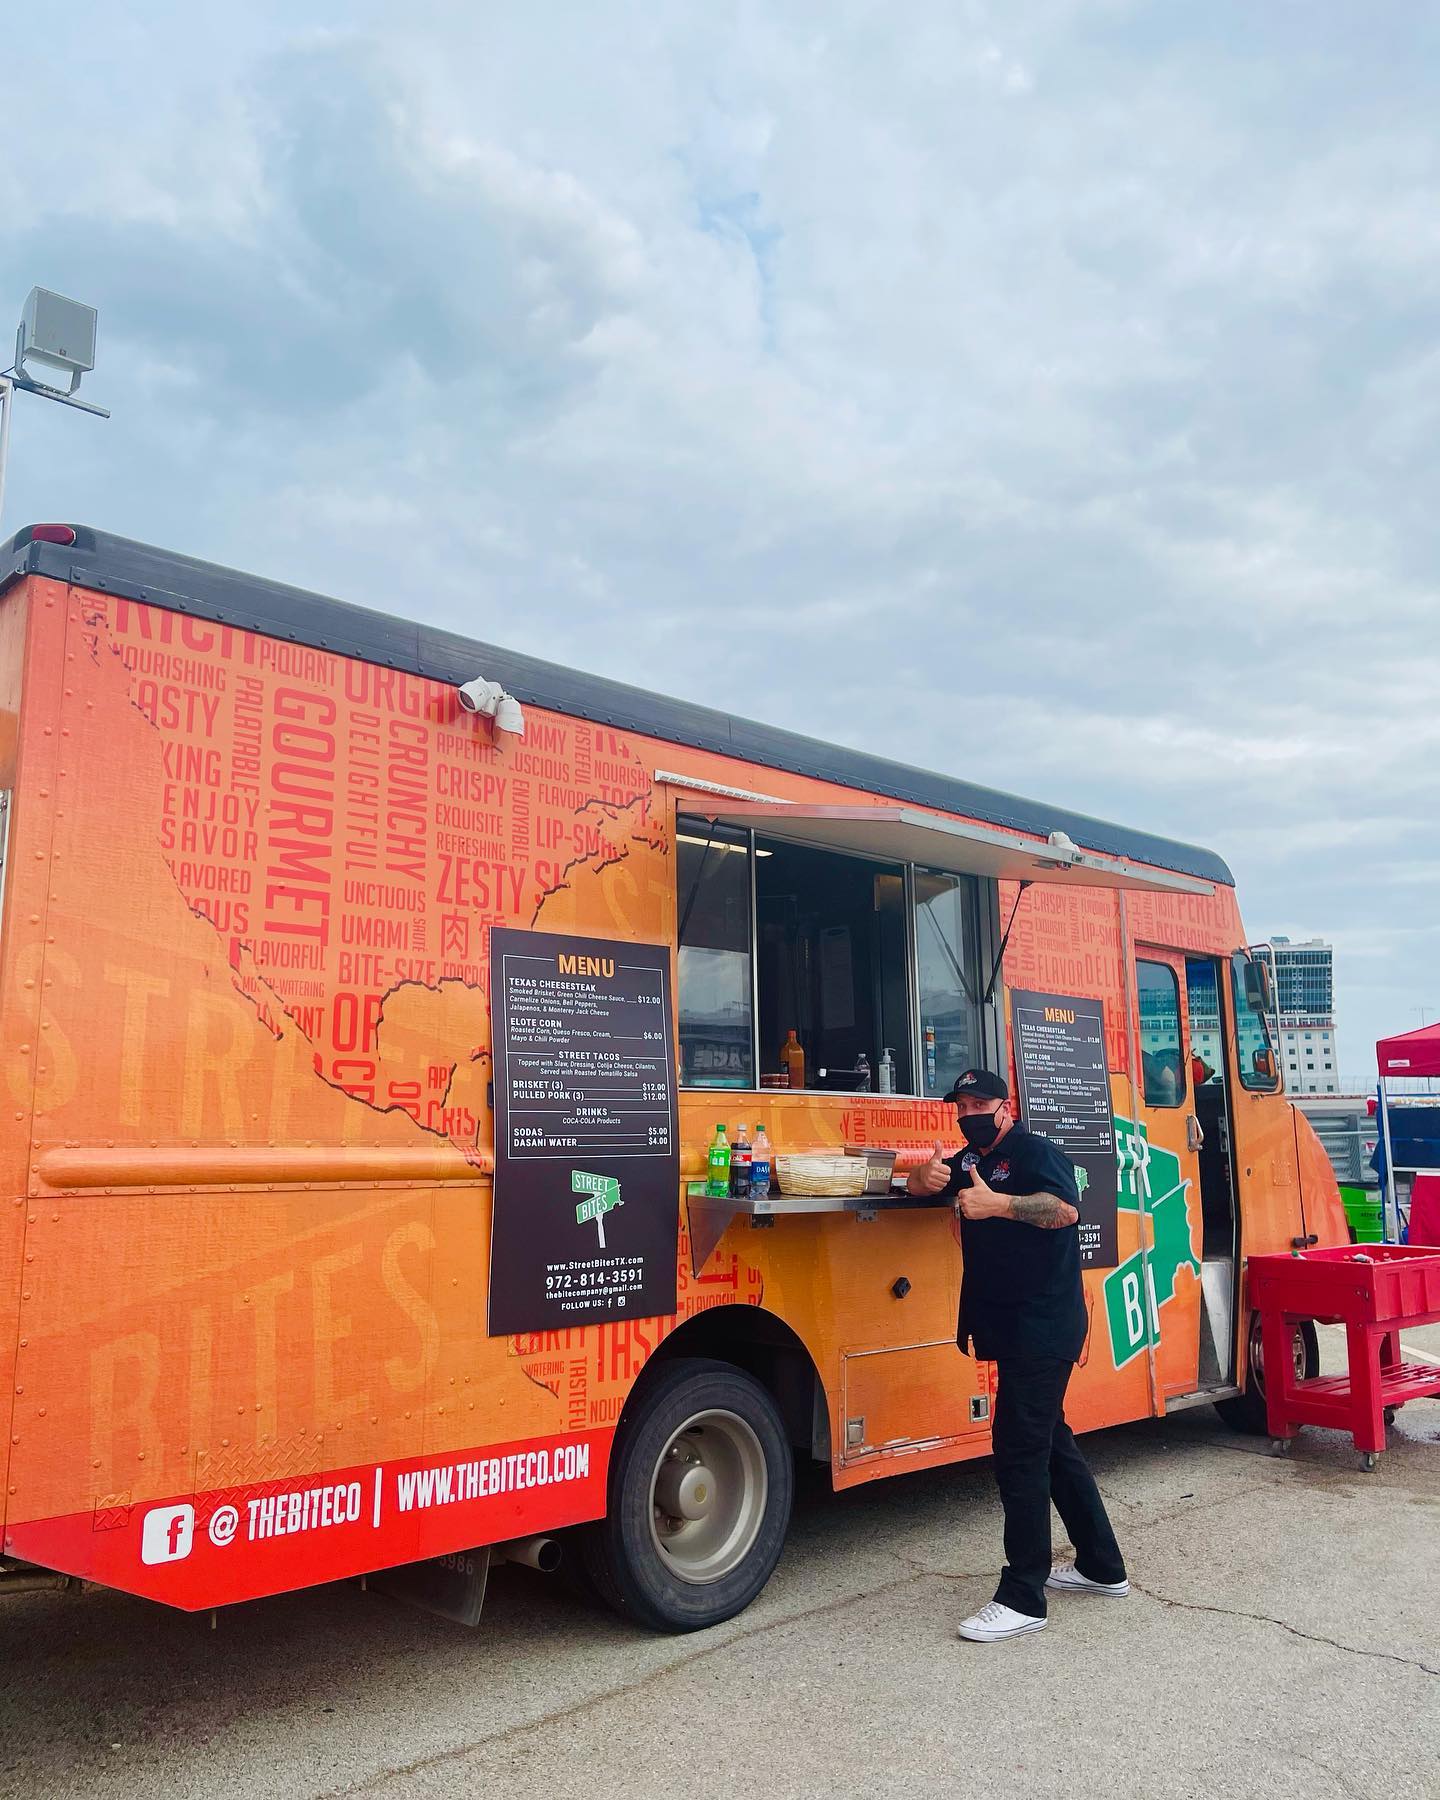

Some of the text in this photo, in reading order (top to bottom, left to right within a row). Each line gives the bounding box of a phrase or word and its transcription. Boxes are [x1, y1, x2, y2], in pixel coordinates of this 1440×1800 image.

[260, 639, 338, 687] PIQUANT
[133, 676, 220, 738] ASTY
[231, 675, 264, 796] PALATABLE
[437, 731, 498, 767] APPETITE
[346, 711, 381, 869] DELIGHTFUL
[436, 763, 507, 806] CRISPY
[163, 784, 260, 827] ENJOY
[385, 719, 429, 883] CRUNCHY
[264, 687, 337, 946] GOURMET
[436, 803, 503, 837] EXQUISITE
[512, 778, 530, 863] ENJOYABLE
[160, 818, 258, 861] SAVOR
[437, 831, 506, 861] REFRESHING
[436, 853, 526, 914] ZESTY
[344, 879, 426, 913] UNCTUOUS
[342, 914, 408, 950] UMAMI
[338, 952, 437, 990] BITE-SIZE
[558, 953, 615, 978] MENU
[509, 978, 596, 992] TEXAS CHEESESTEAK
[509, 987, 533, 996] Smoked
[557, 991, 574, 999] Green
[588, 993, 608, 1001] Cheese
[608, 994, 626, 1003] Sauce,
[637, 995, 661, 1004] $12.00
[509, 995, 539, 1004] Carmelize
[562, 999, 575, 1007] Bell
[576, 1000, 598, 1009] Peppers,
[548, 1006, 575, 1015] Monterey
[575, 1008, 589, 1016] Jack
[589, 1009, 609, 1017] Cheese
[510, 1017, 562, 1028] ELOTE CORN
[1044, 1007, 1075, 1024] MENU
[510, 1026, 663, 1040] Roasted Corn, Queso Fresco, Cream, $6.00
[510, 1034, 528, 1043] Mayo
[518, 1058, 540, 1067] Topped
[558, 1051, 620, 1061] STREET TACOS
[540, 1067, 560, 1076] Served
[561, 1068, 574, 1076] with
[574, 1069, 597, 1077] Roasted
[623, 1070, 638, 1078] Salsa
[512, 1080, 666, 1092] BRISKET (3) $12.00
[513, 1091, 666, 1101] PULLED PORK (3) $12.00
[562, 1117, 596, 1125] COCA-COLA
[576, 1107, 608, 1116] DRINKS
[871, 1110, 912, 1129] FLAVORED
[912, 1101, 954, 1131] TASTY
[514, 1127, 668, 1137] SODAS $5.00
[514, 1137, 668, 1147] DASANI WATER $4.00
[575, 1174, 609, 1193] STREET
[582, 1195, 608, 1220] BITES
[547, 1256, 644, 1272] www.StreetBitesTX.com
[545, 1268, 643, 1290] 972-814-3591
[545, 1283, 643, 1300] thebitecompany@gmail.com
[561, 1299, 605, 1311] FOLLOW US:
[207, 1442, 591, 1547] @ THEBITECO WWW.THEBITECO.COM
